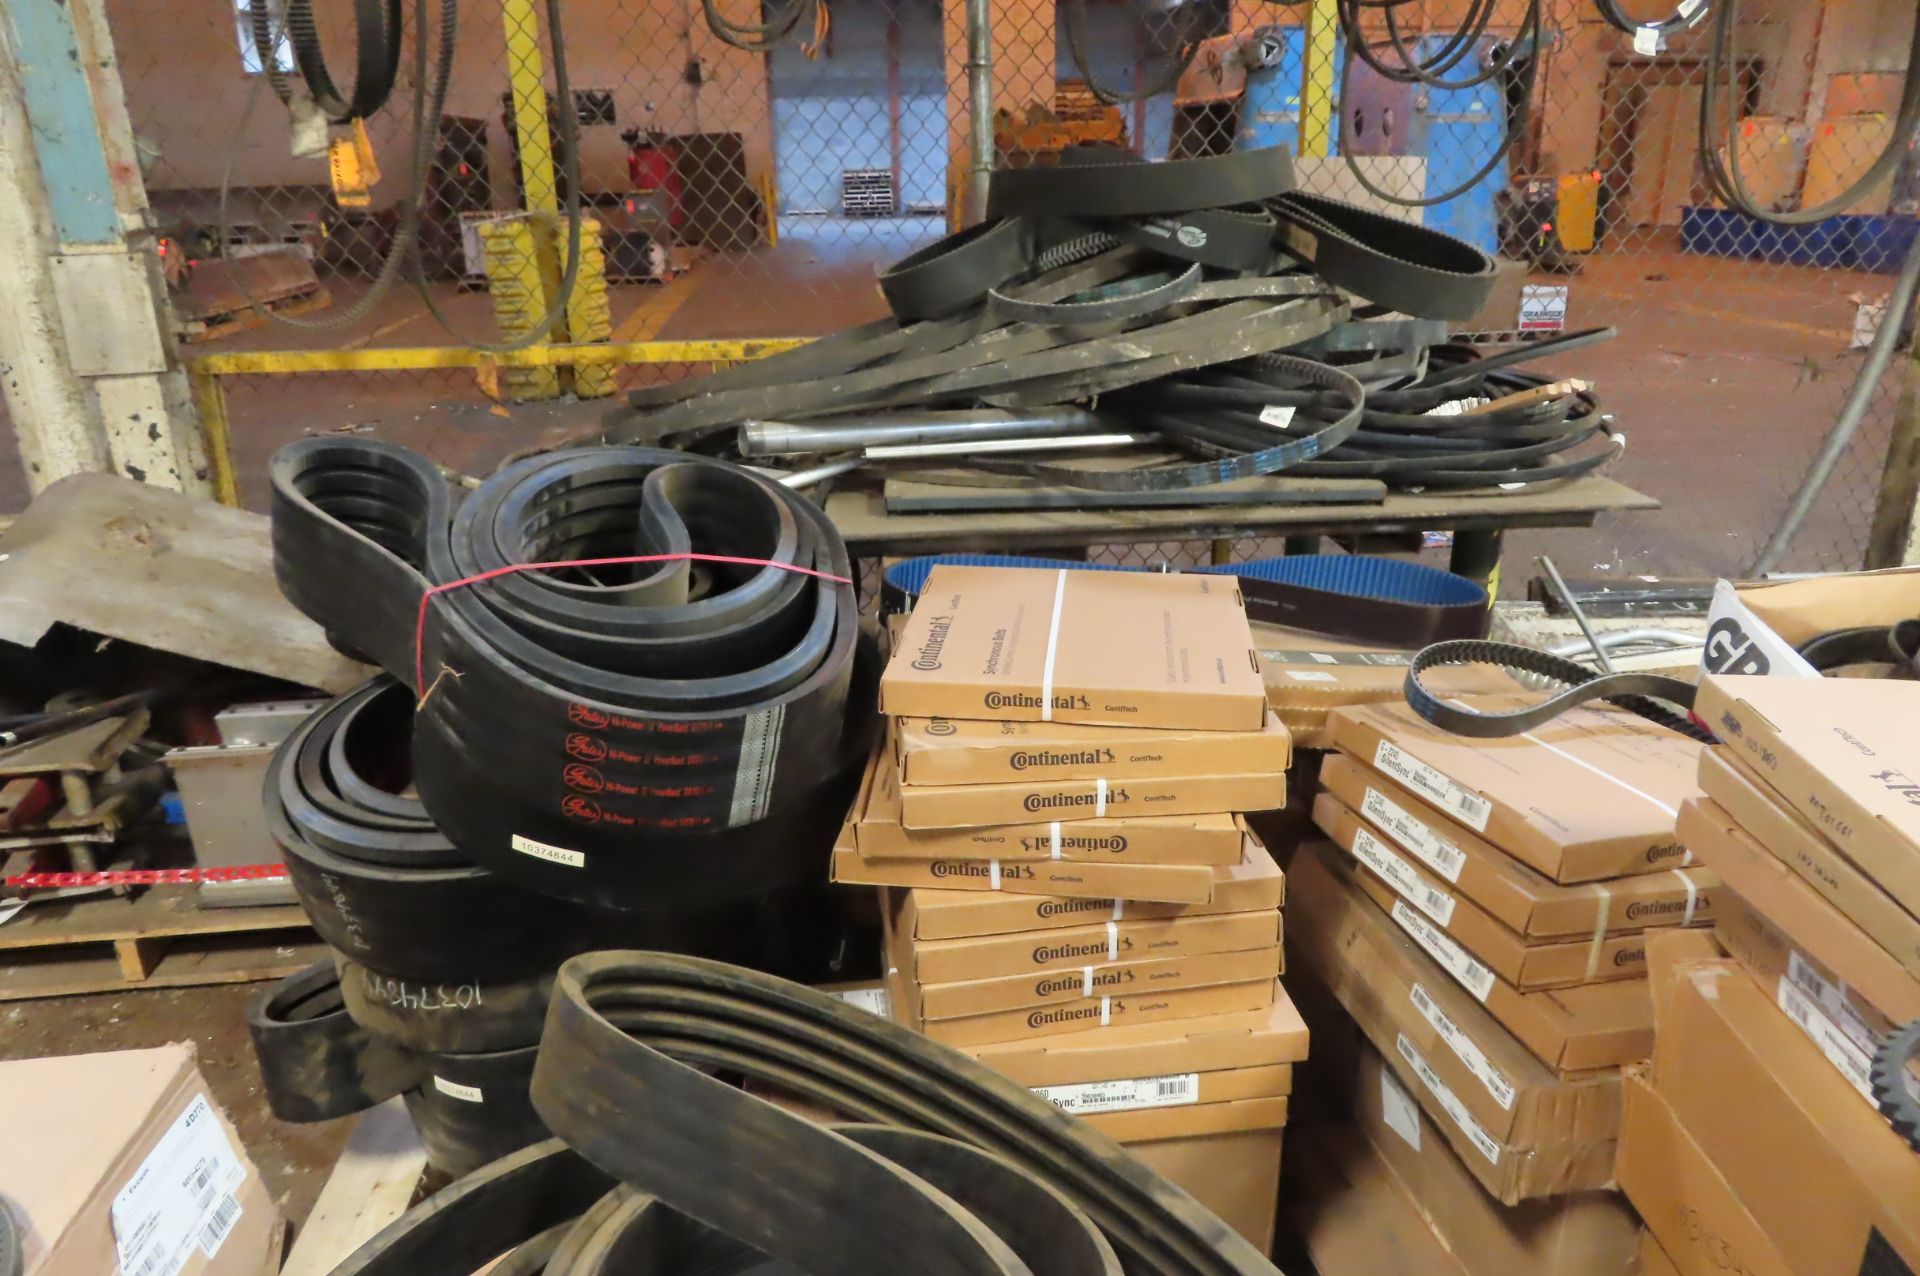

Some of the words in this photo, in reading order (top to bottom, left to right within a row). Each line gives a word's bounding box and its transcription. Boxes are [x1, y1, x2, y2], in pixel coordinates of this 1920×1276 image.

[911, 621, 951, 671] Continental
[984, 691, 1075, 709] Continetal
[1010, 749, 1100, 770] Continental
[1024, 788, 1115, 812] Continenl
[521, 842, 574, 862] 10374844
[1035, 835, 1127, 853] Contineal
[931, 860, 1020, 879] Continetal
[1037, 899, 1116, 918] Continenta
[1626, 897, 1700, 920] Continenl
[1033, 938, 1119, 963] Continentl
[1036, 971, 1121, 996] Continntal
[1028, 1003, 1112, 1028] Continentl
